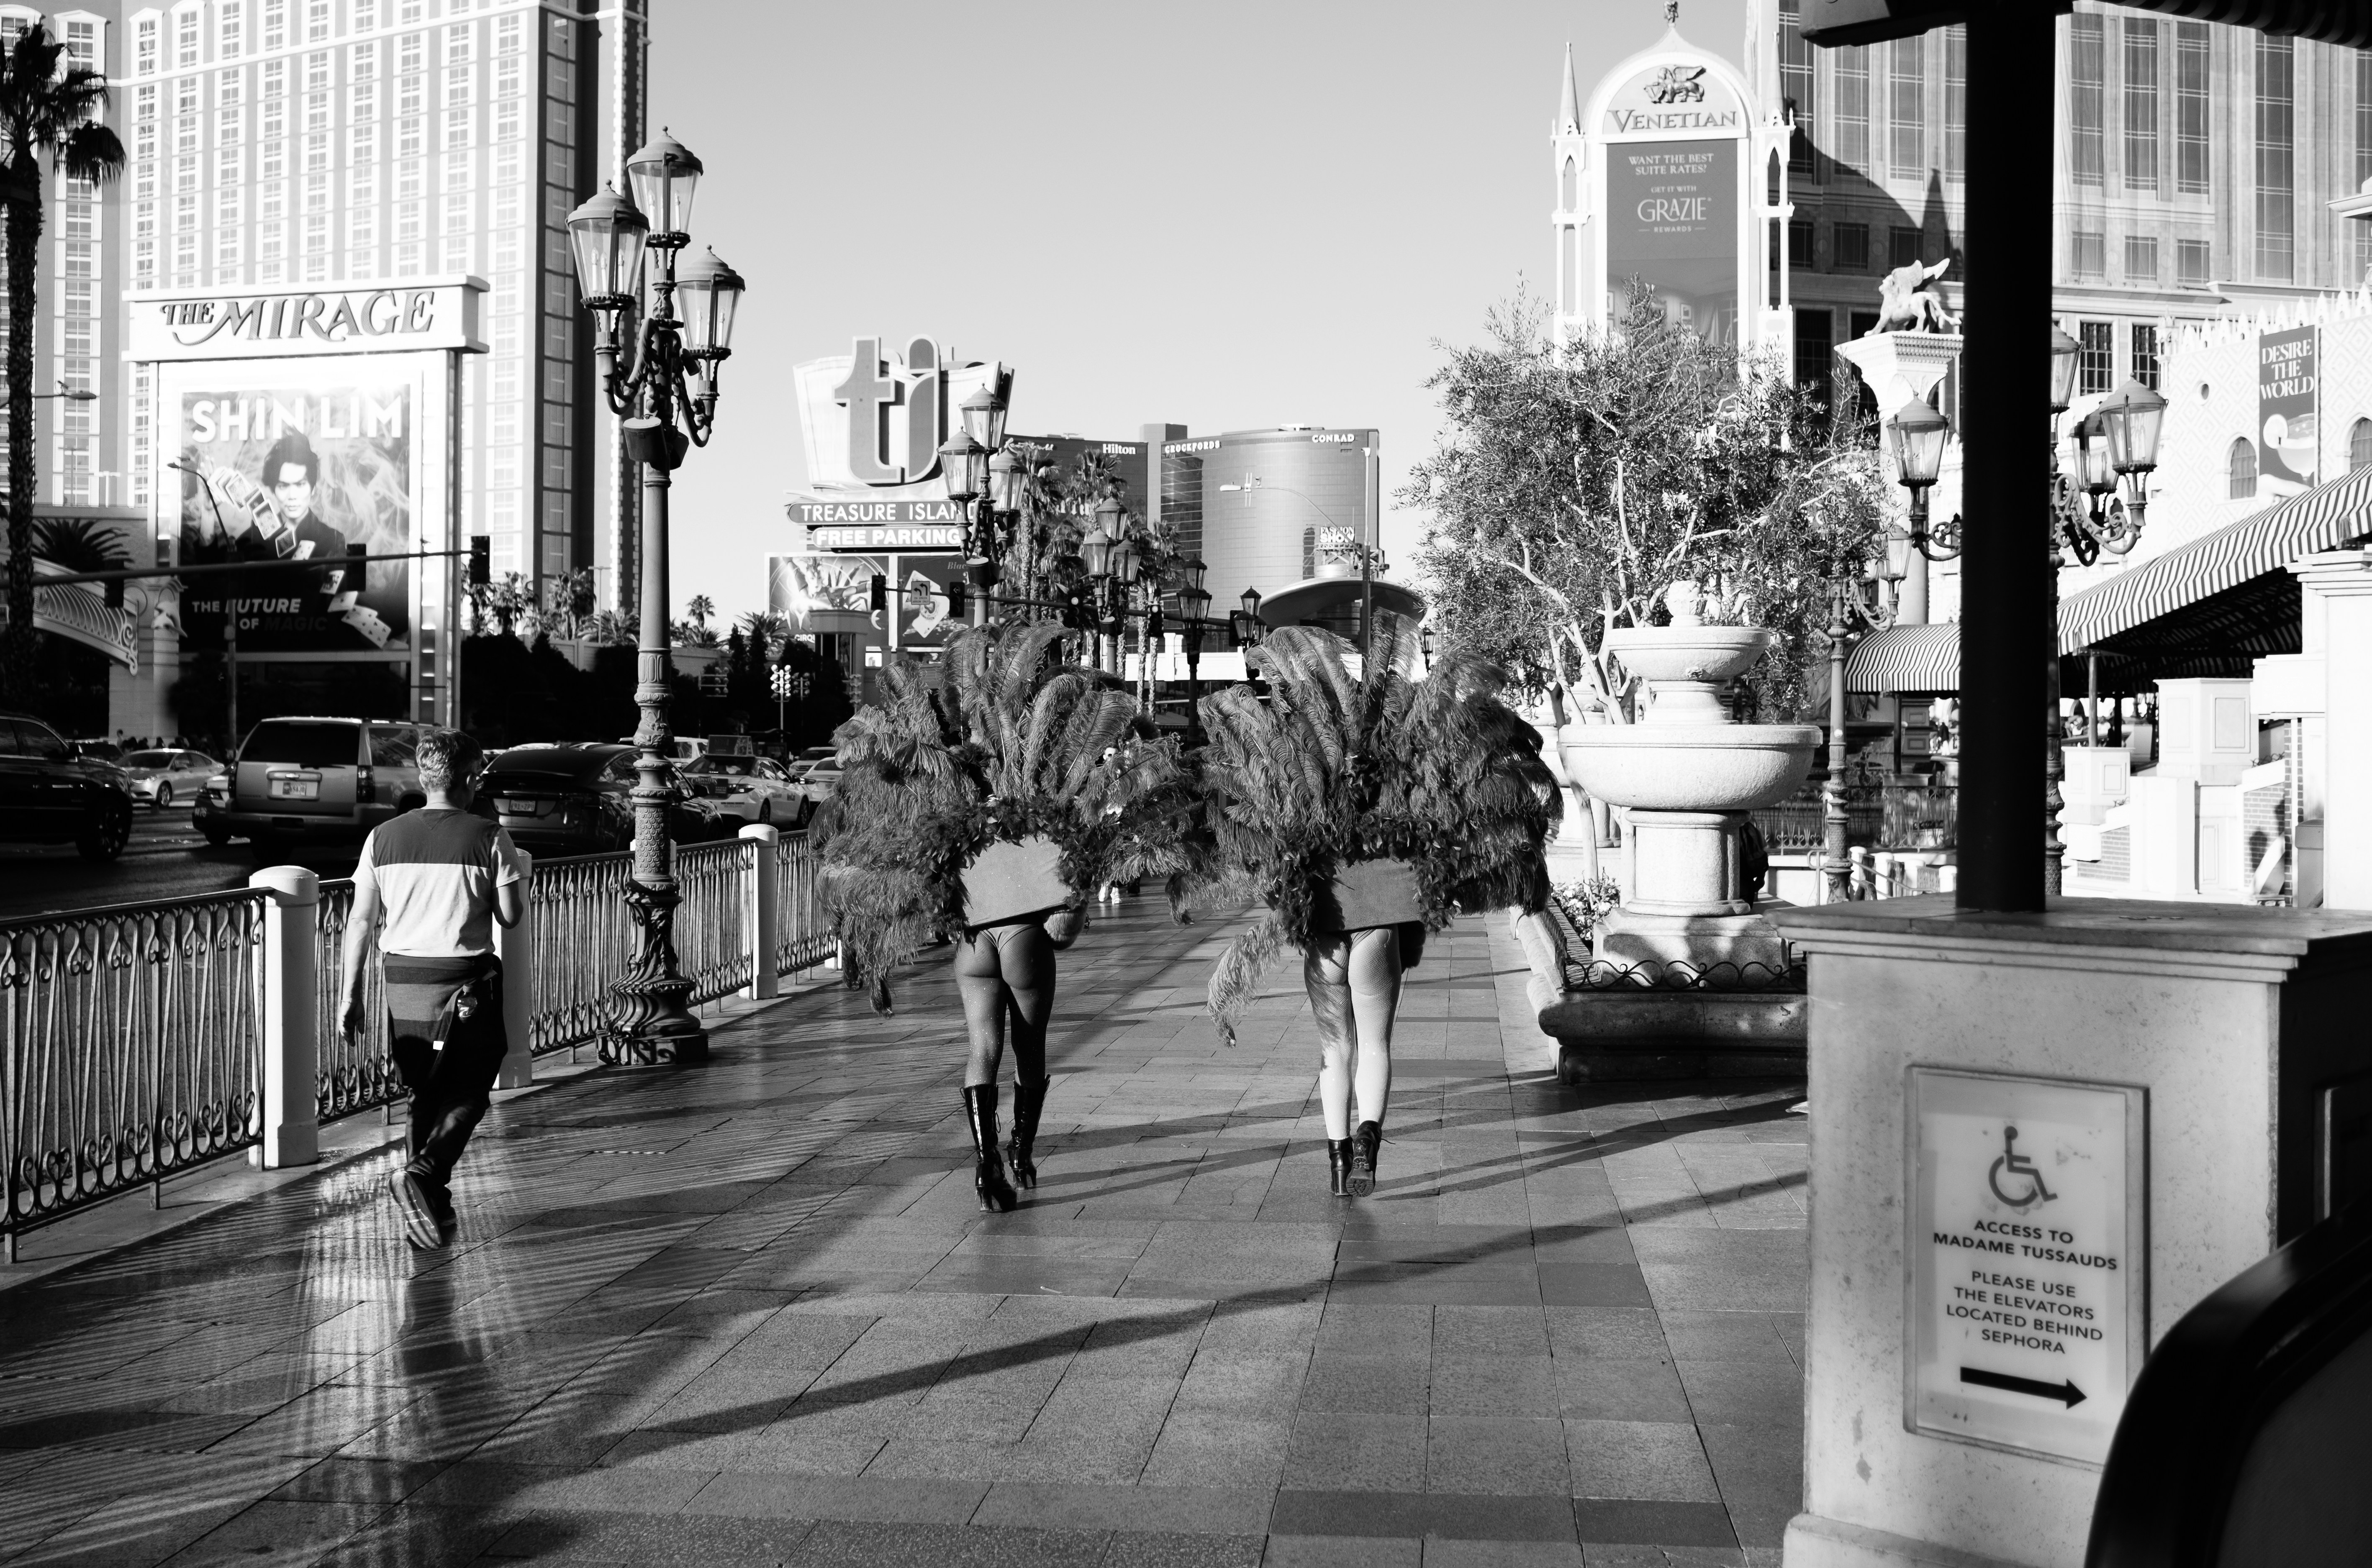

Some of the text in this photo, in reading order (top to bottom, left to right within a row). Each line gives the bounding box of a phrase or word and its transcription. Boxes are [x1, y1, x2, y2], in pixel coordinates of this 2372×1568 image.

[1607, 109, 1737, 133] VENETIAN
[1628, 153, 1714, 165] WANT THE BEST
[1635, 164, 1707, 175] SUITE RATES?
[160, 291, 435, 346] THE MIRAGE
[2262, 339, 2313, 364] DESIRE
[2271, 359, 2302, 380] THE
[2260, 376, 2315, 400] WORLD
[192, 395, 401, 443] SHIN LIM
[1102, 443, 1136, 455] Hilton
[1165, 441, 1222, 453] CROCKFORDS
[1312, 433, 1355, 443] CONRAD
[801, 503, 896, 521] TREASURE
[816, 528, 961, 545] FREE PARKING
[192, 600, 220, 613] THE
[239, 616, 328, 631] OF MAGIC
[1974, 1220, 2074, 1244] ACCESS TO
[1933, 1232, 2118, 1270] MADAME TUSSAUDS
[1972, 1271, 2076, 1298] PLEASE USE
[1954, 1286, 2095, 1320] THE ELEVATORS
[1946, 1304, 2103, 1340] LOCATED BEHIND
[1981, 1328, 2066, 1354] SEPHORA
